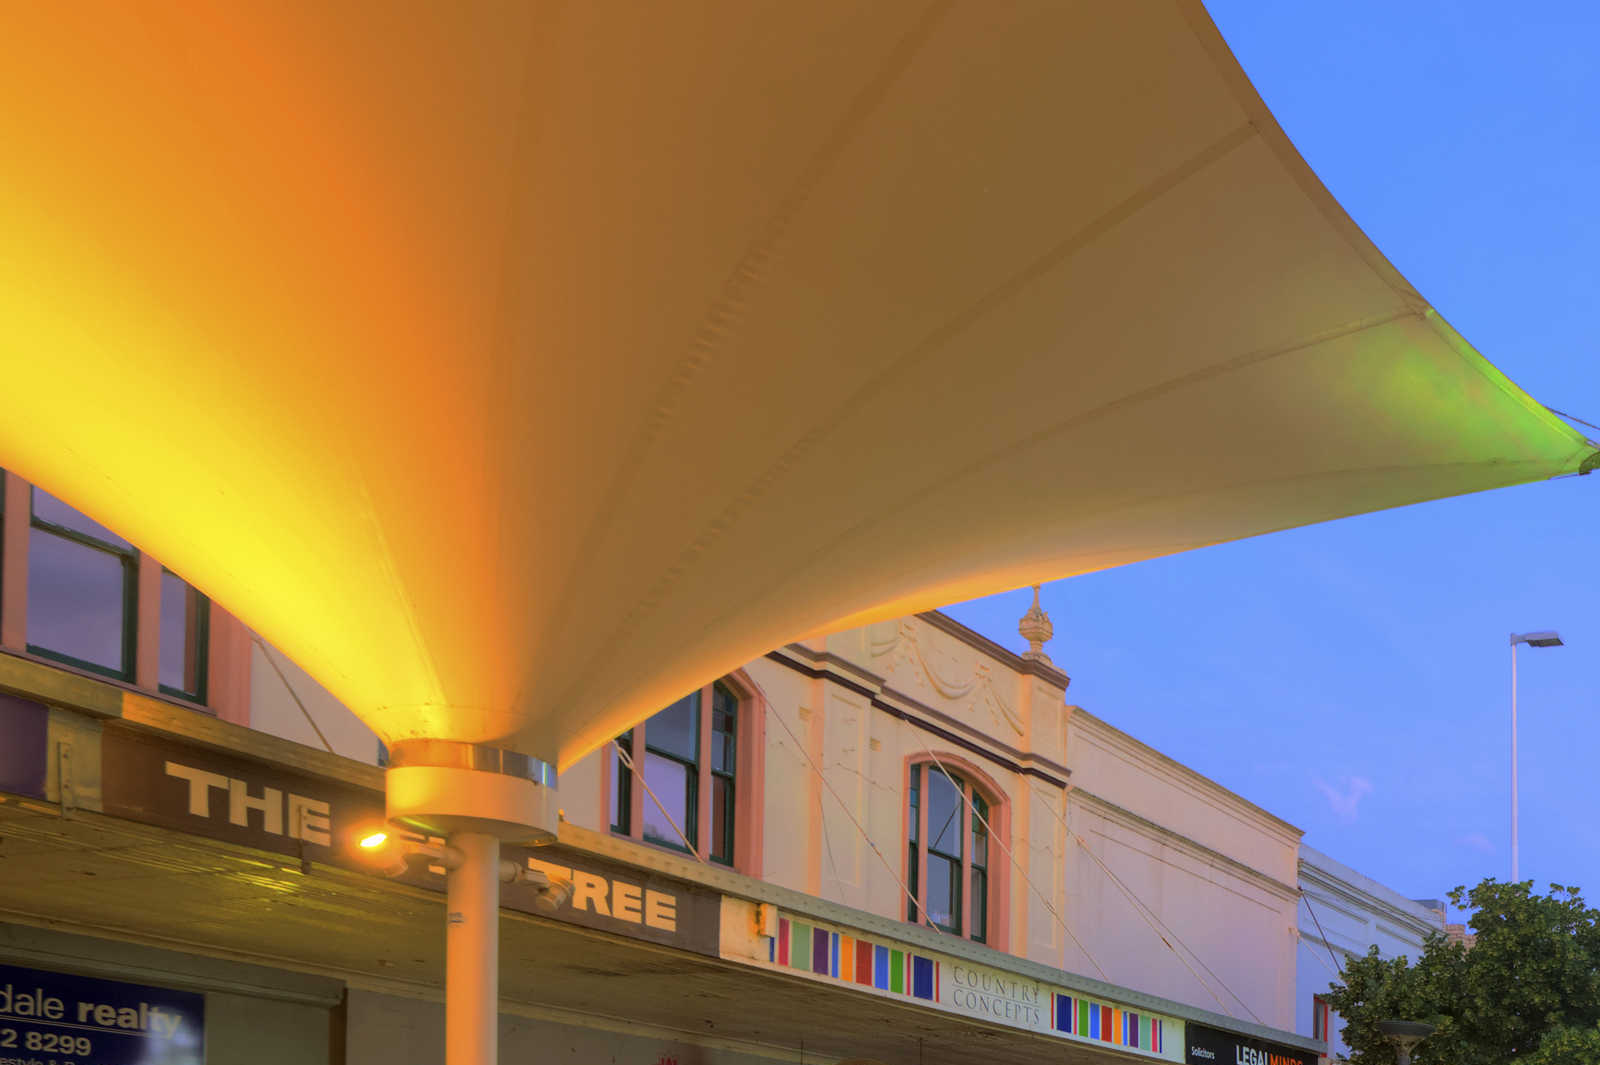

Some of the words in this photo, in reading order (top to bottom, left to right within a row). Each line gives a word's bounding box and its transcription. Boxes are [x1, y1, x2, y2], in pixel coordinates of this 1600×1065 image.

[165, 761, 331, 848] THE
[953, 966, 1040, 1003] COUNTRY
[78, 1001, 182, 1040] realty
[953, 989, 1039, 1024] CONCEPTS
[26, 1031, 91, 1056] 8299
[1191, 1046, 1216, 1060] Solicitors
